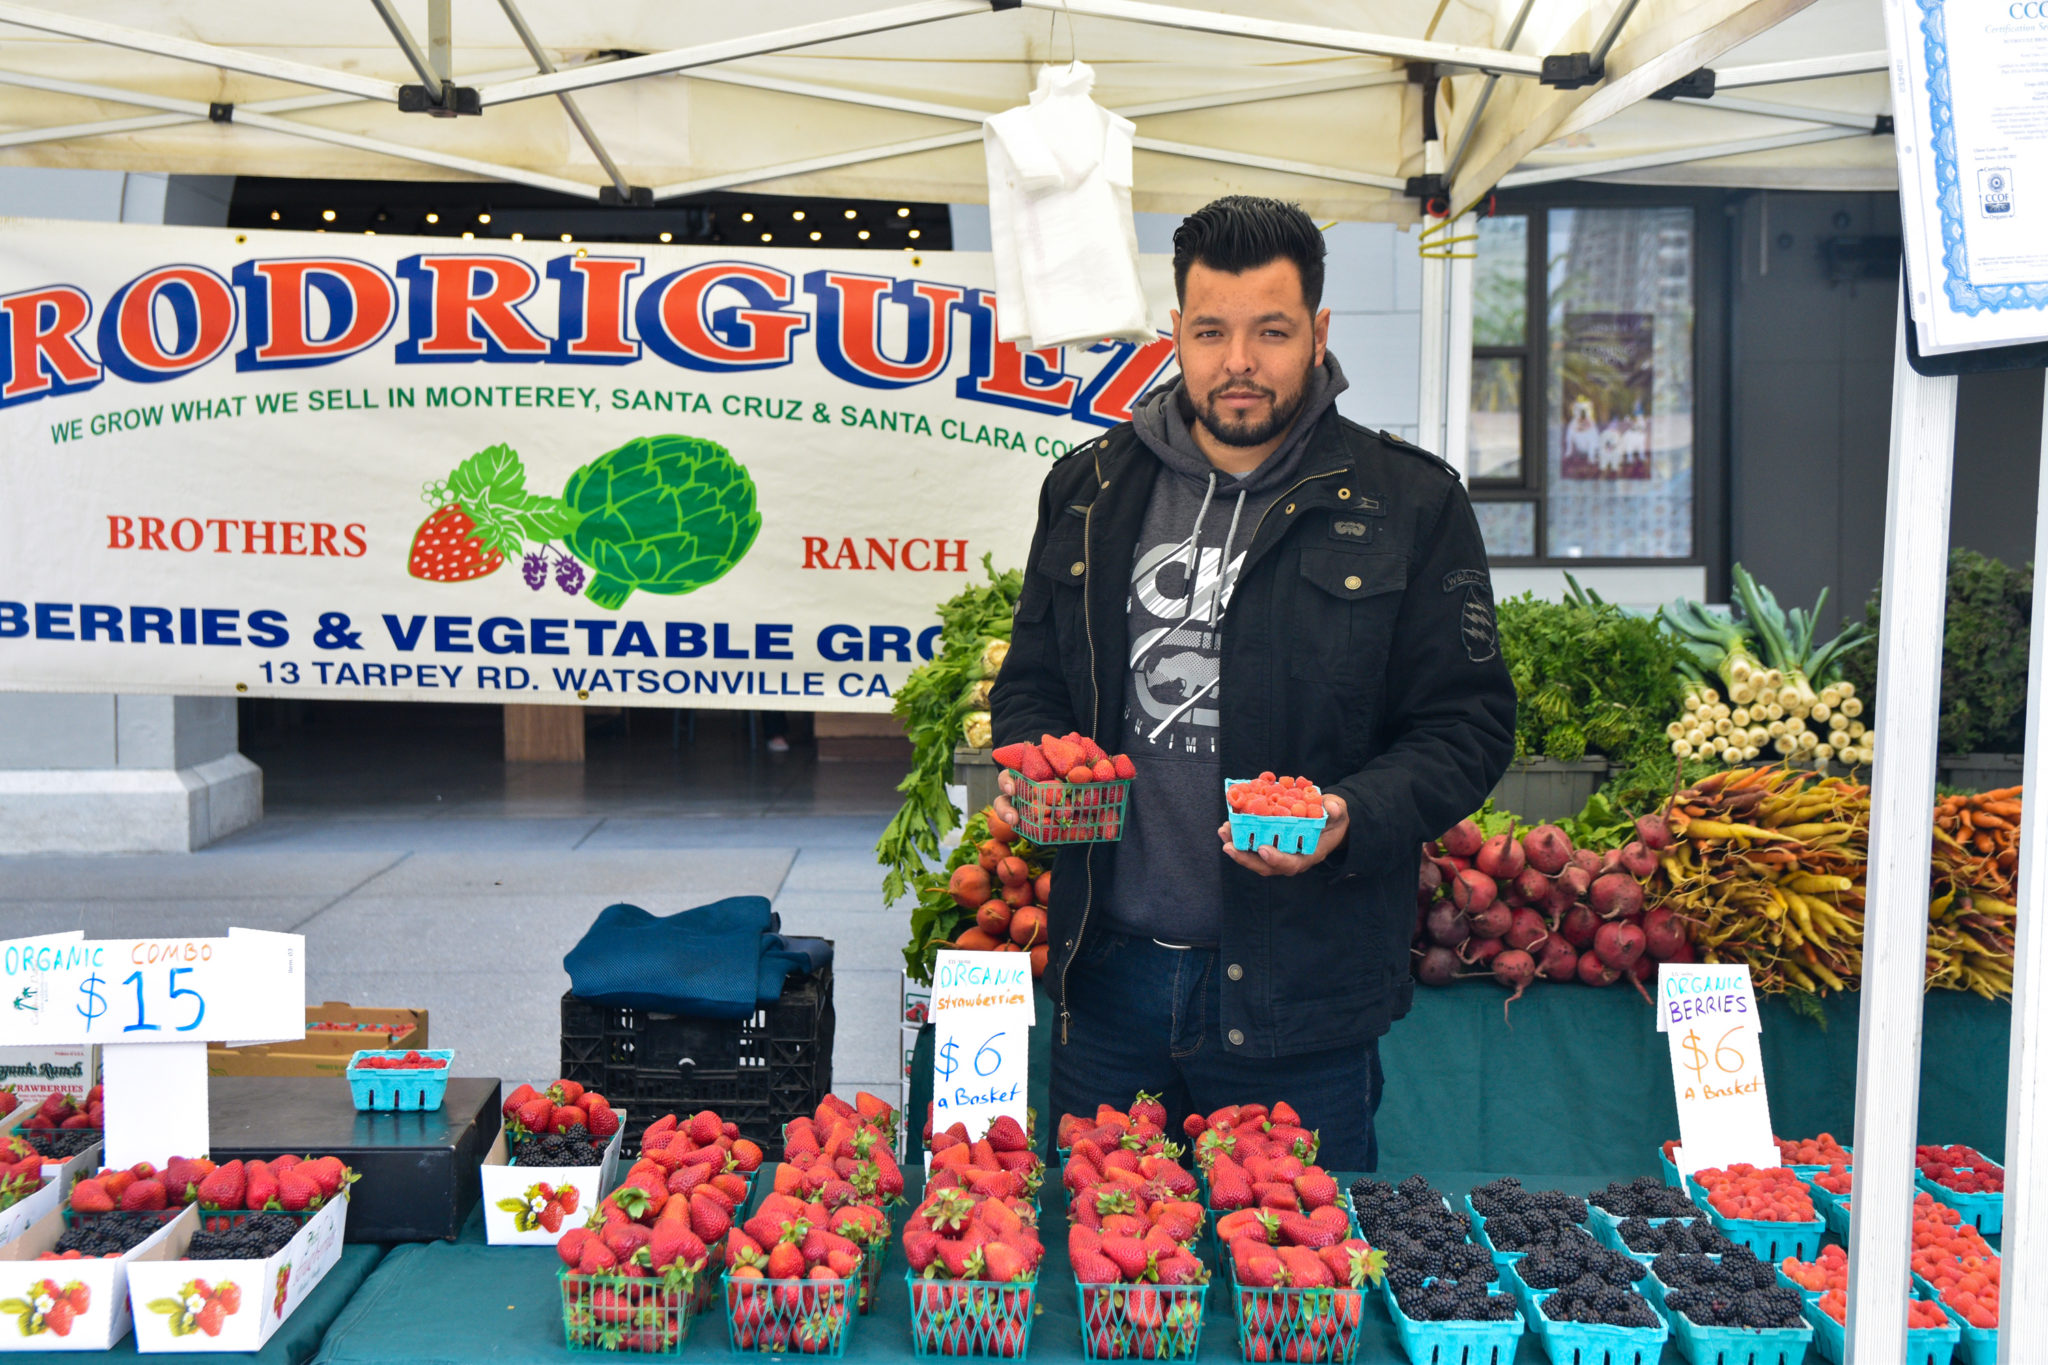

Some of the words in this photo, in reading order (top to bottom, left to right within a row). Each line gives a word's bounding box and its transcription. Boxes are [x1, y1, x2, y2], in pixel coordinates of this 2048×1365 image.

[1984, 23, 2036, 35] Certification
[1985, 193, 2009, 202] CCOF
[51, 421, 84, 445] WE
[90, 404, 165, 436] GROW
[171, 396, 247, 423] WHAT
[255, 391, 299, 413] WE
[308, 387, 379, 410] SELL
[388, 387, 415, 408] IN
[425, 386, 600, 413] MONTEREY,
[611, 388, 713, 414] SANTA
[722, 394, 803, 422] CRUZ
[812, 402, 831, 424] &
[841, 405, 932, 439] SANTA
[941, 418, 1028, 453] CLARA
[107, 514, 368, 558] BROTHERS
[801, 536, 969, 573] RANCH
[0, 601, 290, 648] BERRIES
[312, 612, 364, 650] &
[382, 614, 794, 660] VEGETABLE
[259, 661, 299, 685] 13
[312, 662, 464, 689] TARPEY
[477, 666, 538, 691] RD.
[553, 667, 825, 697] WATSONVILLE
[838, 672, 891, 698] CA
[5, 946, 104, 976] ORGANIC
[131, 942, 213, 965] COMBO
[940, 962, 1025, 988] ORGANIC
[1666, 976, 1745, 999] ORGANIC
[937, 988, 1026, 1010] strawberries
[1669, 994, 1748, 1024] BERRIES
[39, 1061, 83, 1081] Ranch
[938, 1096, 949, 1109] a
[955, 1082, 1022, 1106] Basket
[1685, 1087, 1695, 1100] A
[1704, 1074, 1765, 1100] Basket
